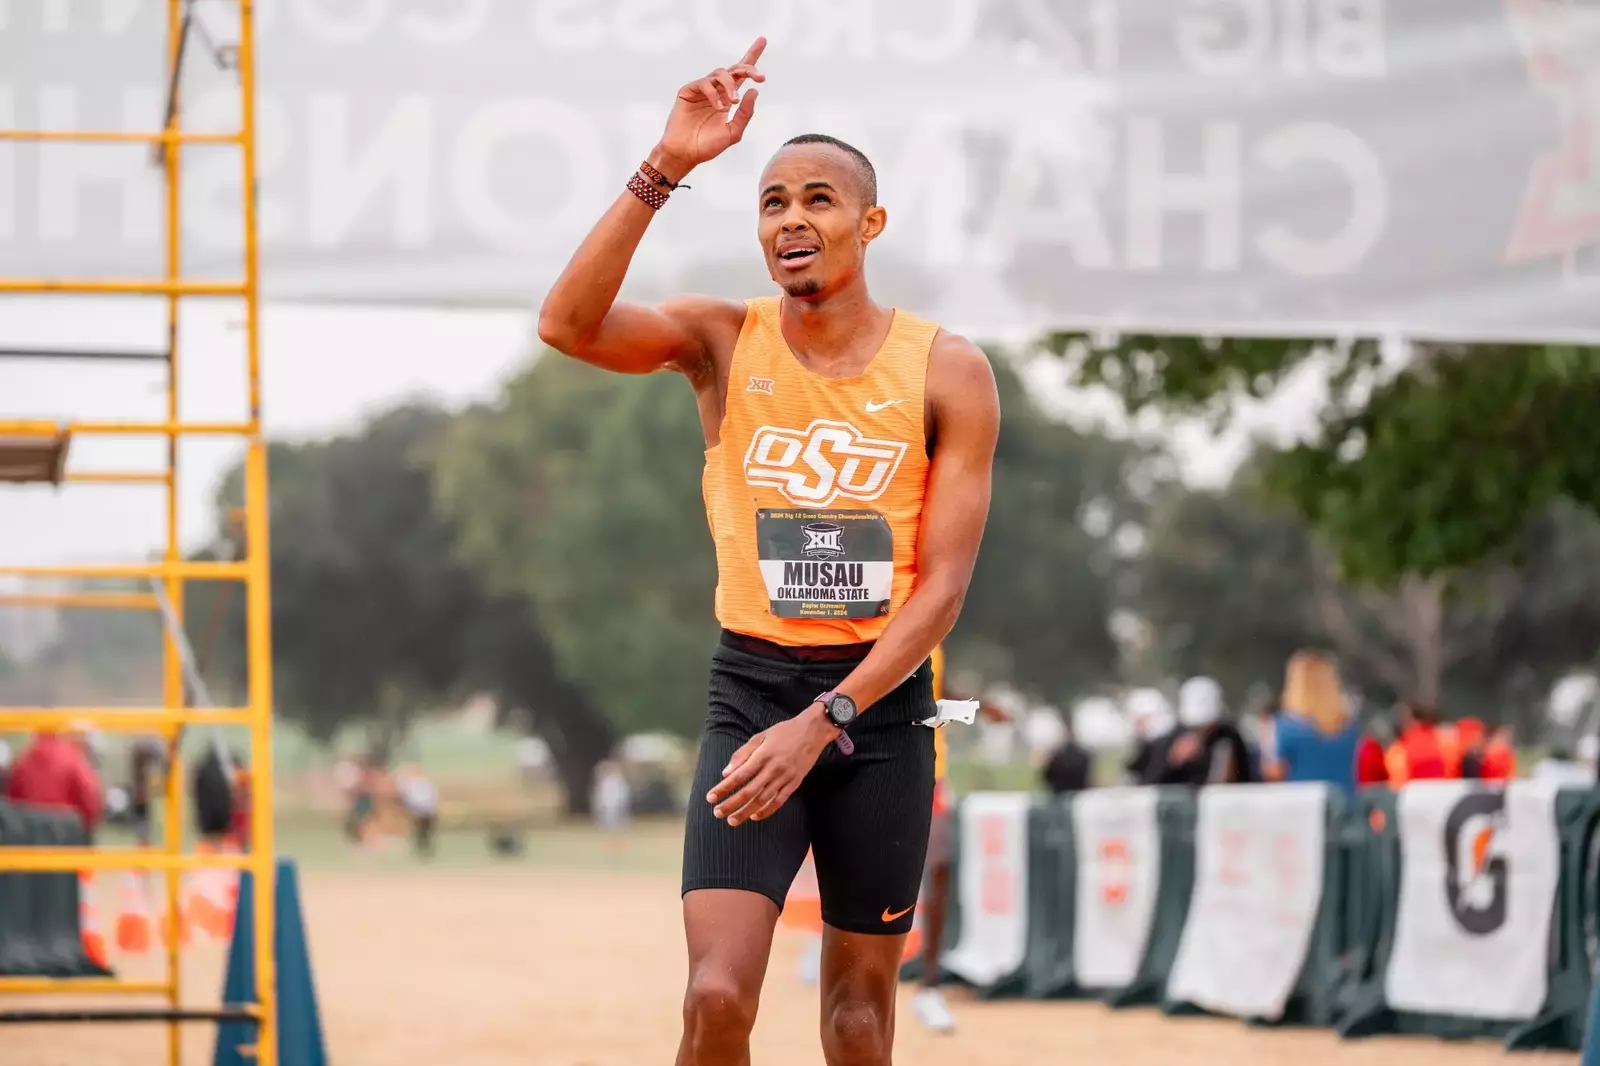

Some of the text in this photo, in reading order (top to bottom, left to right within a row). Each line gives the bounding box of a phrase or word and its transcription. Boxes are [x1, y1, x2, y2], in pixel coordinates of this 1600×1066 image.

[744, 420, 905, 506] OSU
[783, 562, 863, 587] MUSAU
[777, 586, 869, 601] OKLAHOMA STATE
